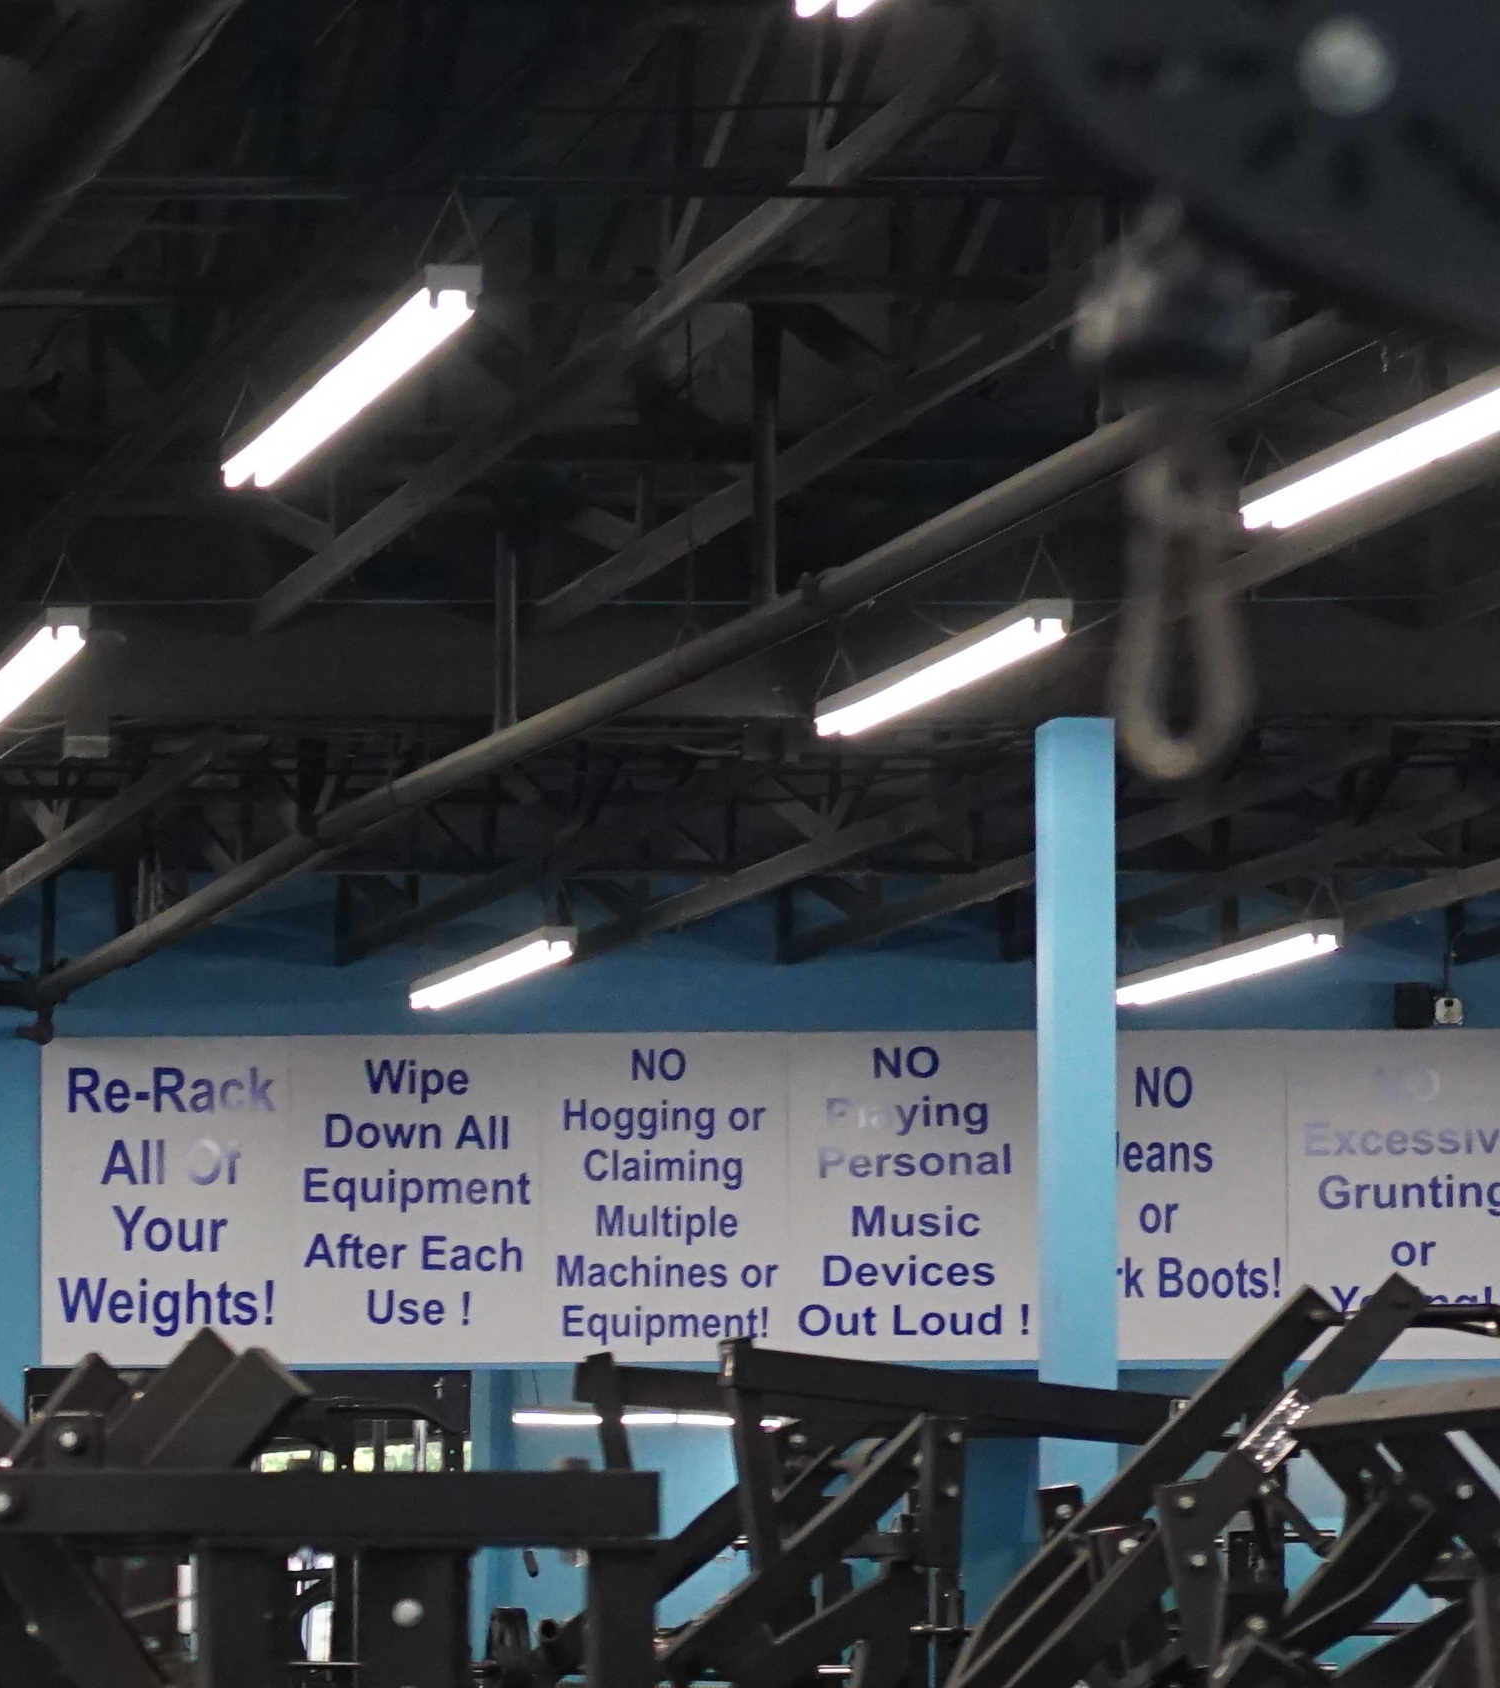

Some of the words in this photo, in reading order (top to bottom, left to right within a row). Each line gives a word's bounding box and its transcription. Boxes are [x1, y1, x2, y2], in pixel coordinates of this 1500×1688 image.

[365, 1060, 469, 1103] Wipe
[632, 1048, 685, 1082] NO
[873, 1046, 941, 1079] NO
[67, 1066, 276, 1114] Re-Rack
[1135, 1065, 1194, 1109] NO
[324, 1113, 442, 1149] Down
[456, 1115, 509, 1150] All
[563, 1100, 716, 1141] Hogging
[729, 1107, 767, 1132] or
[101, 1139, 163, 1185] All
[583, 1149, 743, 1191] Claiming
[817, 1143, 1012, 1179] Personal
[1116, 1131, 1214, 1174] eans
[304, 1167, 531, 1213] Equipment
[113, 1205, 227, 1254] Your
[596, 1205, 739, 1245] Multiple
[851, 1205, 979, 1238] Music
[1138, 1202, 1179, 1235] or
[303, 1233, 407, 1271] After
[420, 1234, 523, 1272] Each
[556, 1254, 728, 1288] Machines
[740, 1264, 778, 1288] or
[822, 1254, 996, 1287] Devices
[1391, 1241, 1435, 1267] or
[1157, 1256, 1281, 1300] Boots!
[57, 1277, 275, 1337] Weights!
[367, 1290, 446, 1326] Use
[562, 1304, 769, 1343] Equipment!
[798, 1304, 877, 1337] Out
[892, 1305, 1003, 1337] Loud
